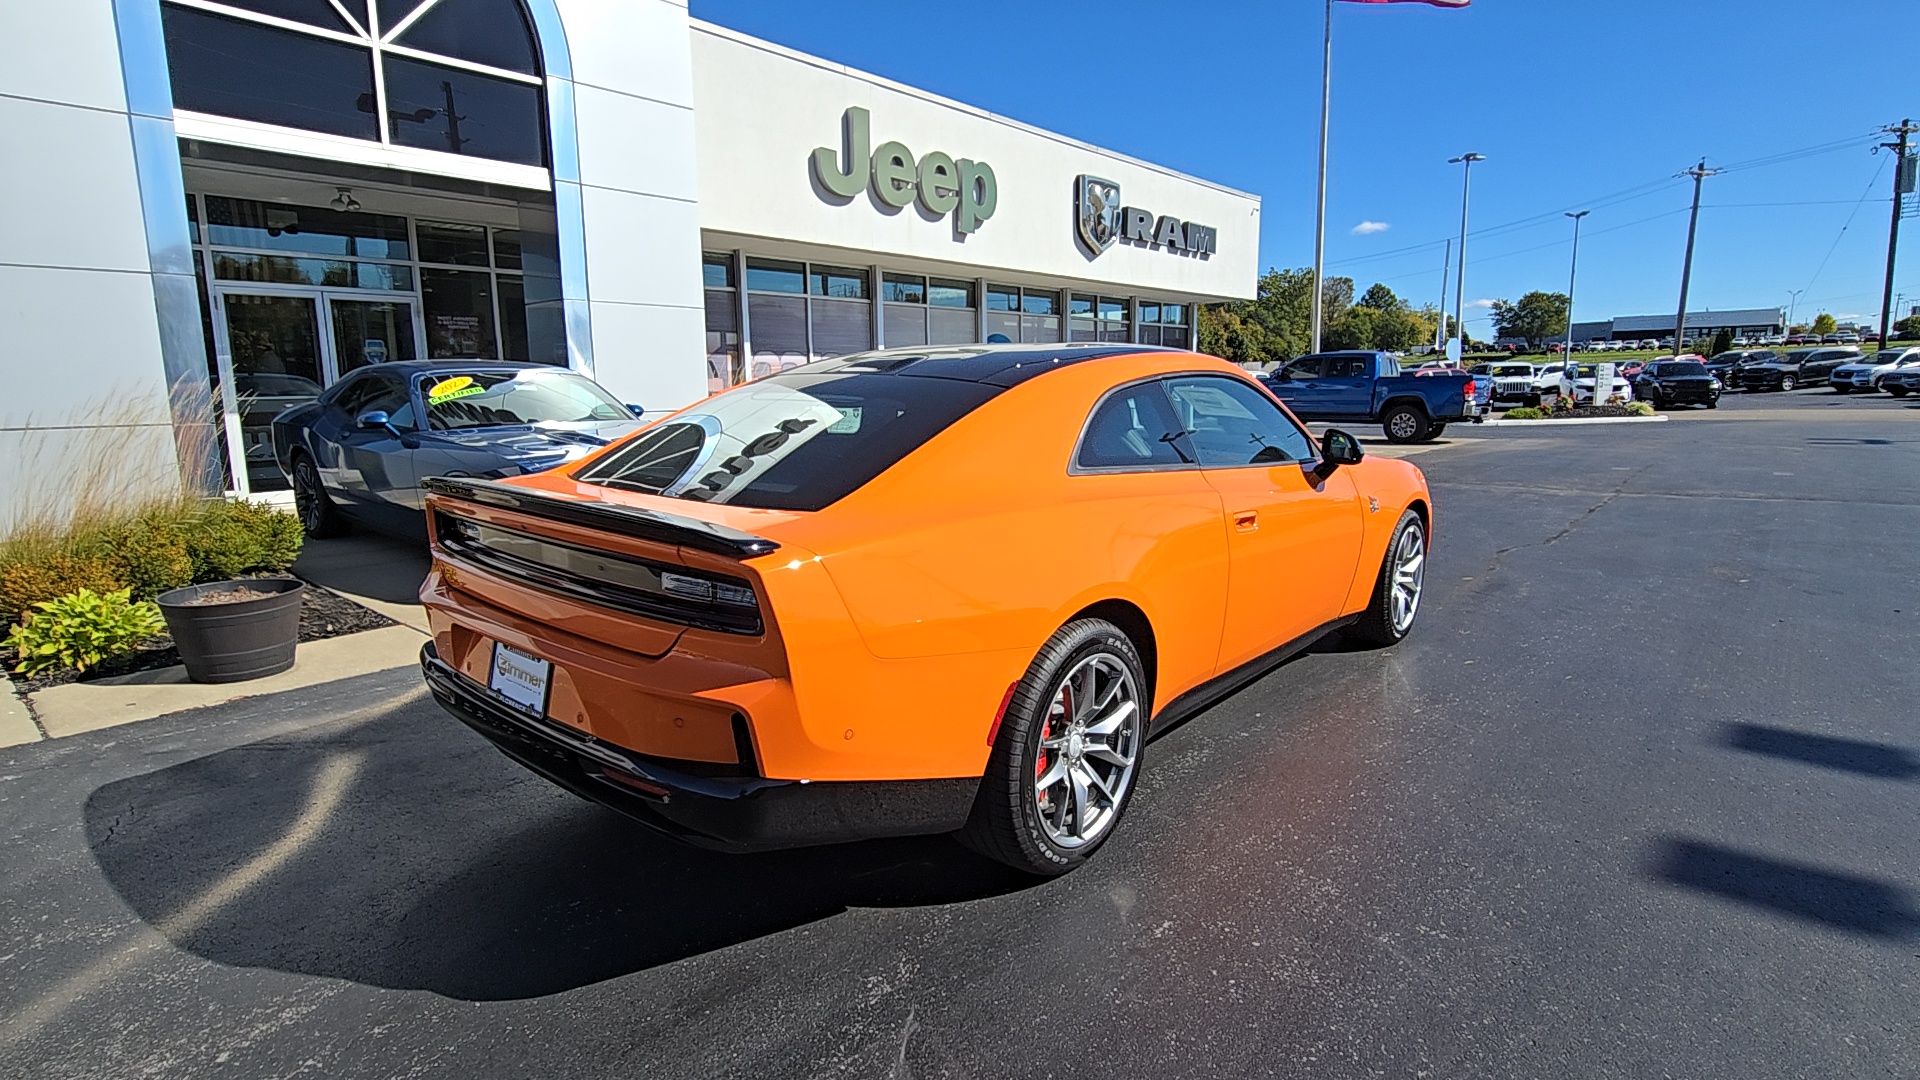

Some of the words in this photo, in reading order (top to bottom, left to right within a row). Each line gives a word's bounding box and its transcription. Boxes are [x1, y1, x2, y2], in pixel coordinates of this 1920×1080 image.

[811, 106, 997, 234] Jeep
[1121, 206, 1217, 256] RAM
[431, 387, 482, 404] CERTIFIED
[437, 378, 466, 394] 2023
[498, 654, 545, 688] Zimmer
